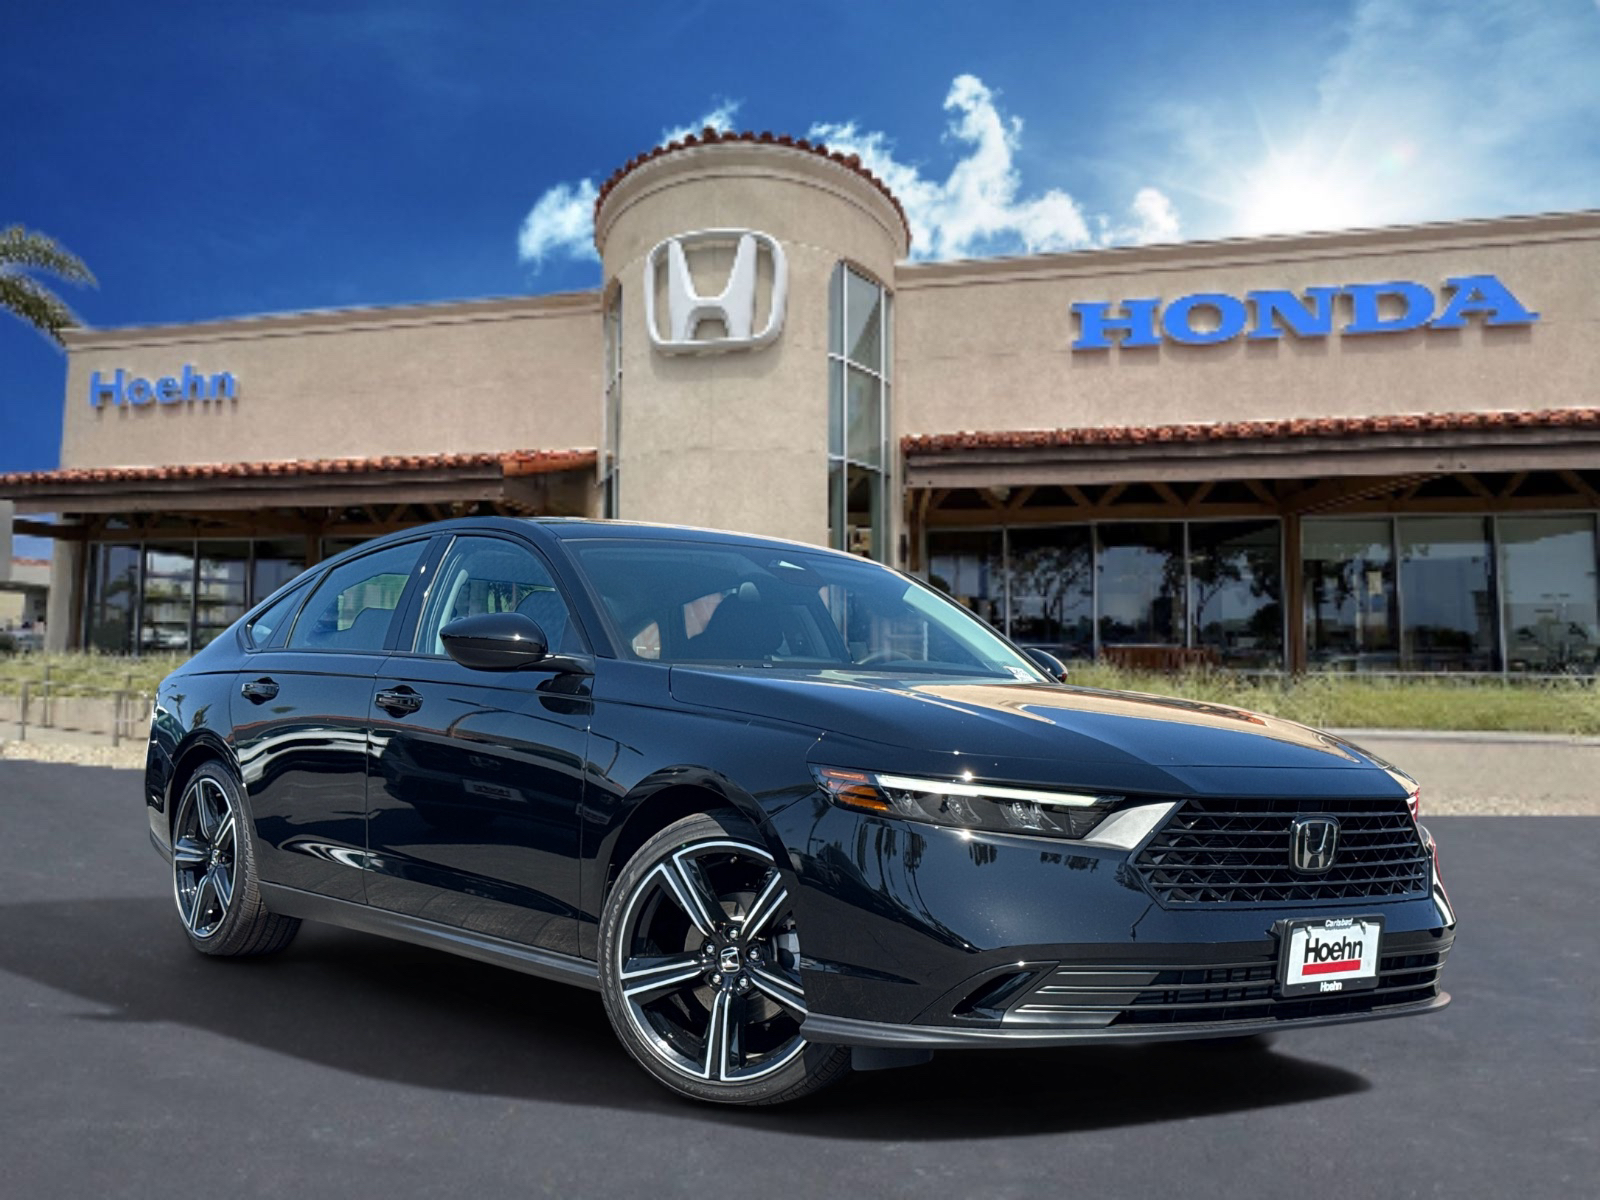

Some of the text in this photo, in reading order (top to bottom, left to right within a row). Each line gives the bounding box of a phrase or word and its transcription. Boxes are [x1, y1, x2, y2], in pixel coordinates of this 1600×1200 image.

[1071, 274, 1540, 349] HONDA
[90, 363, 236, 406] Hoehn
[1324, 918, 1353, 928] Carlsbad
[1304, 936, 1363, 963] Hoehn
[1320, 981, 1342, 992] Hoehn
